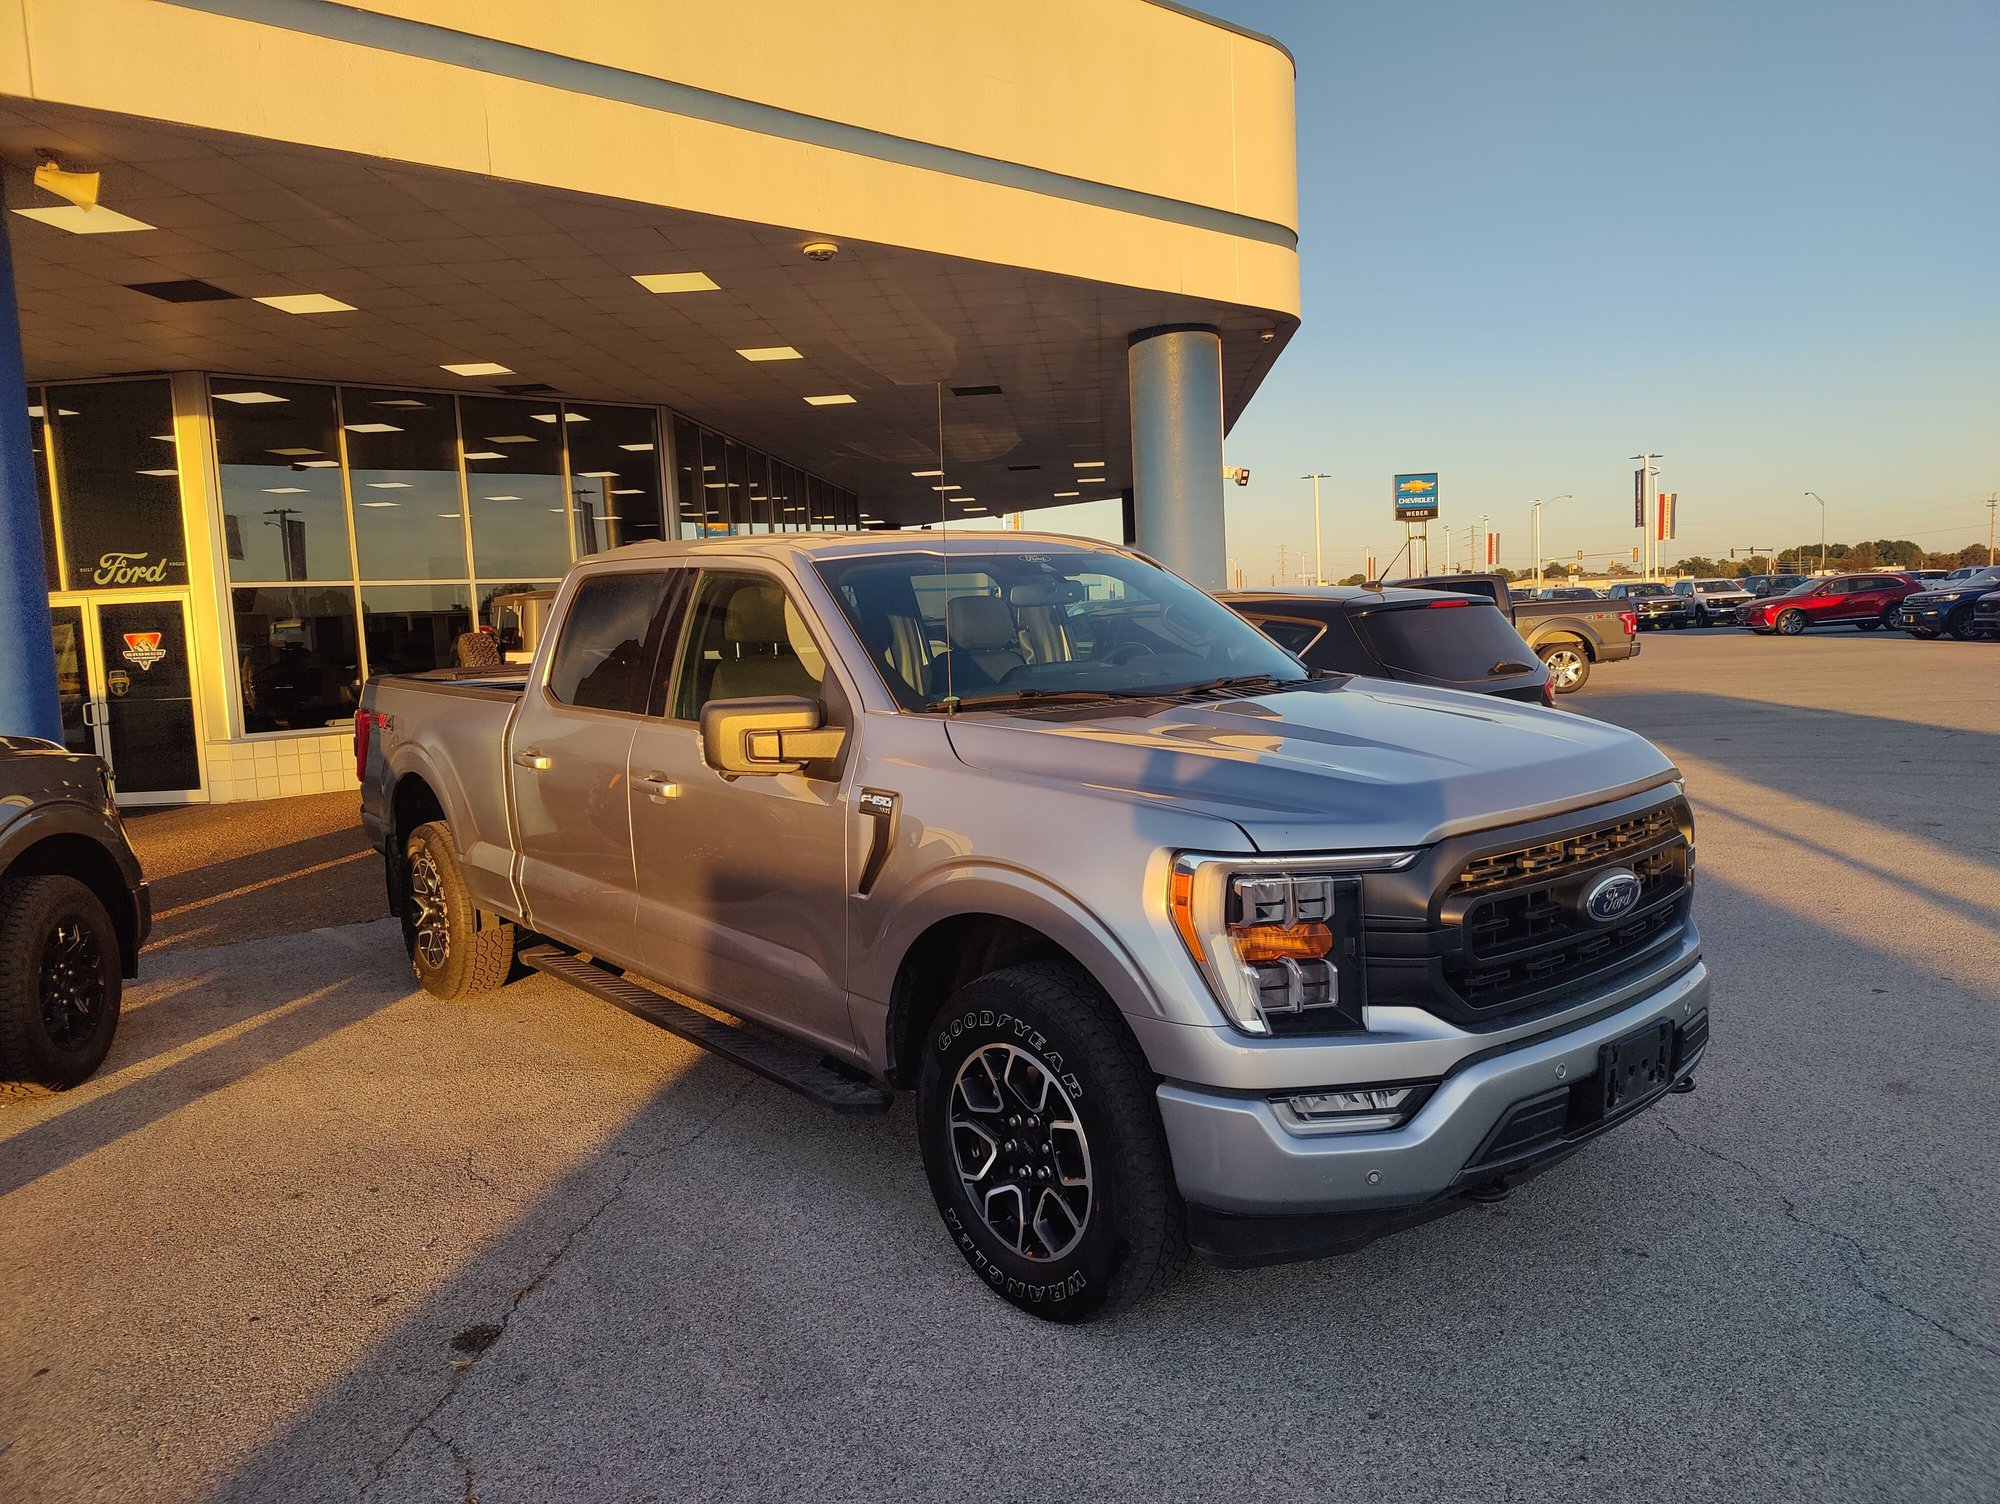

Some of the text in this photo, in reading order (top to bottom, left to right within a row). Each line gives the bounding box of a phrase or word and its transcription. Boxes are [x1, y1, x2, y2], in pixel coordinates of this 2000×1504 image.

[93, 552, 167, 585] Ford
[1603, 884, 1633, 913] Ford
[937, 1009, 1085, 1100] GOODYEAR
[944, 1206, 1087, 1304] WRANGLER
